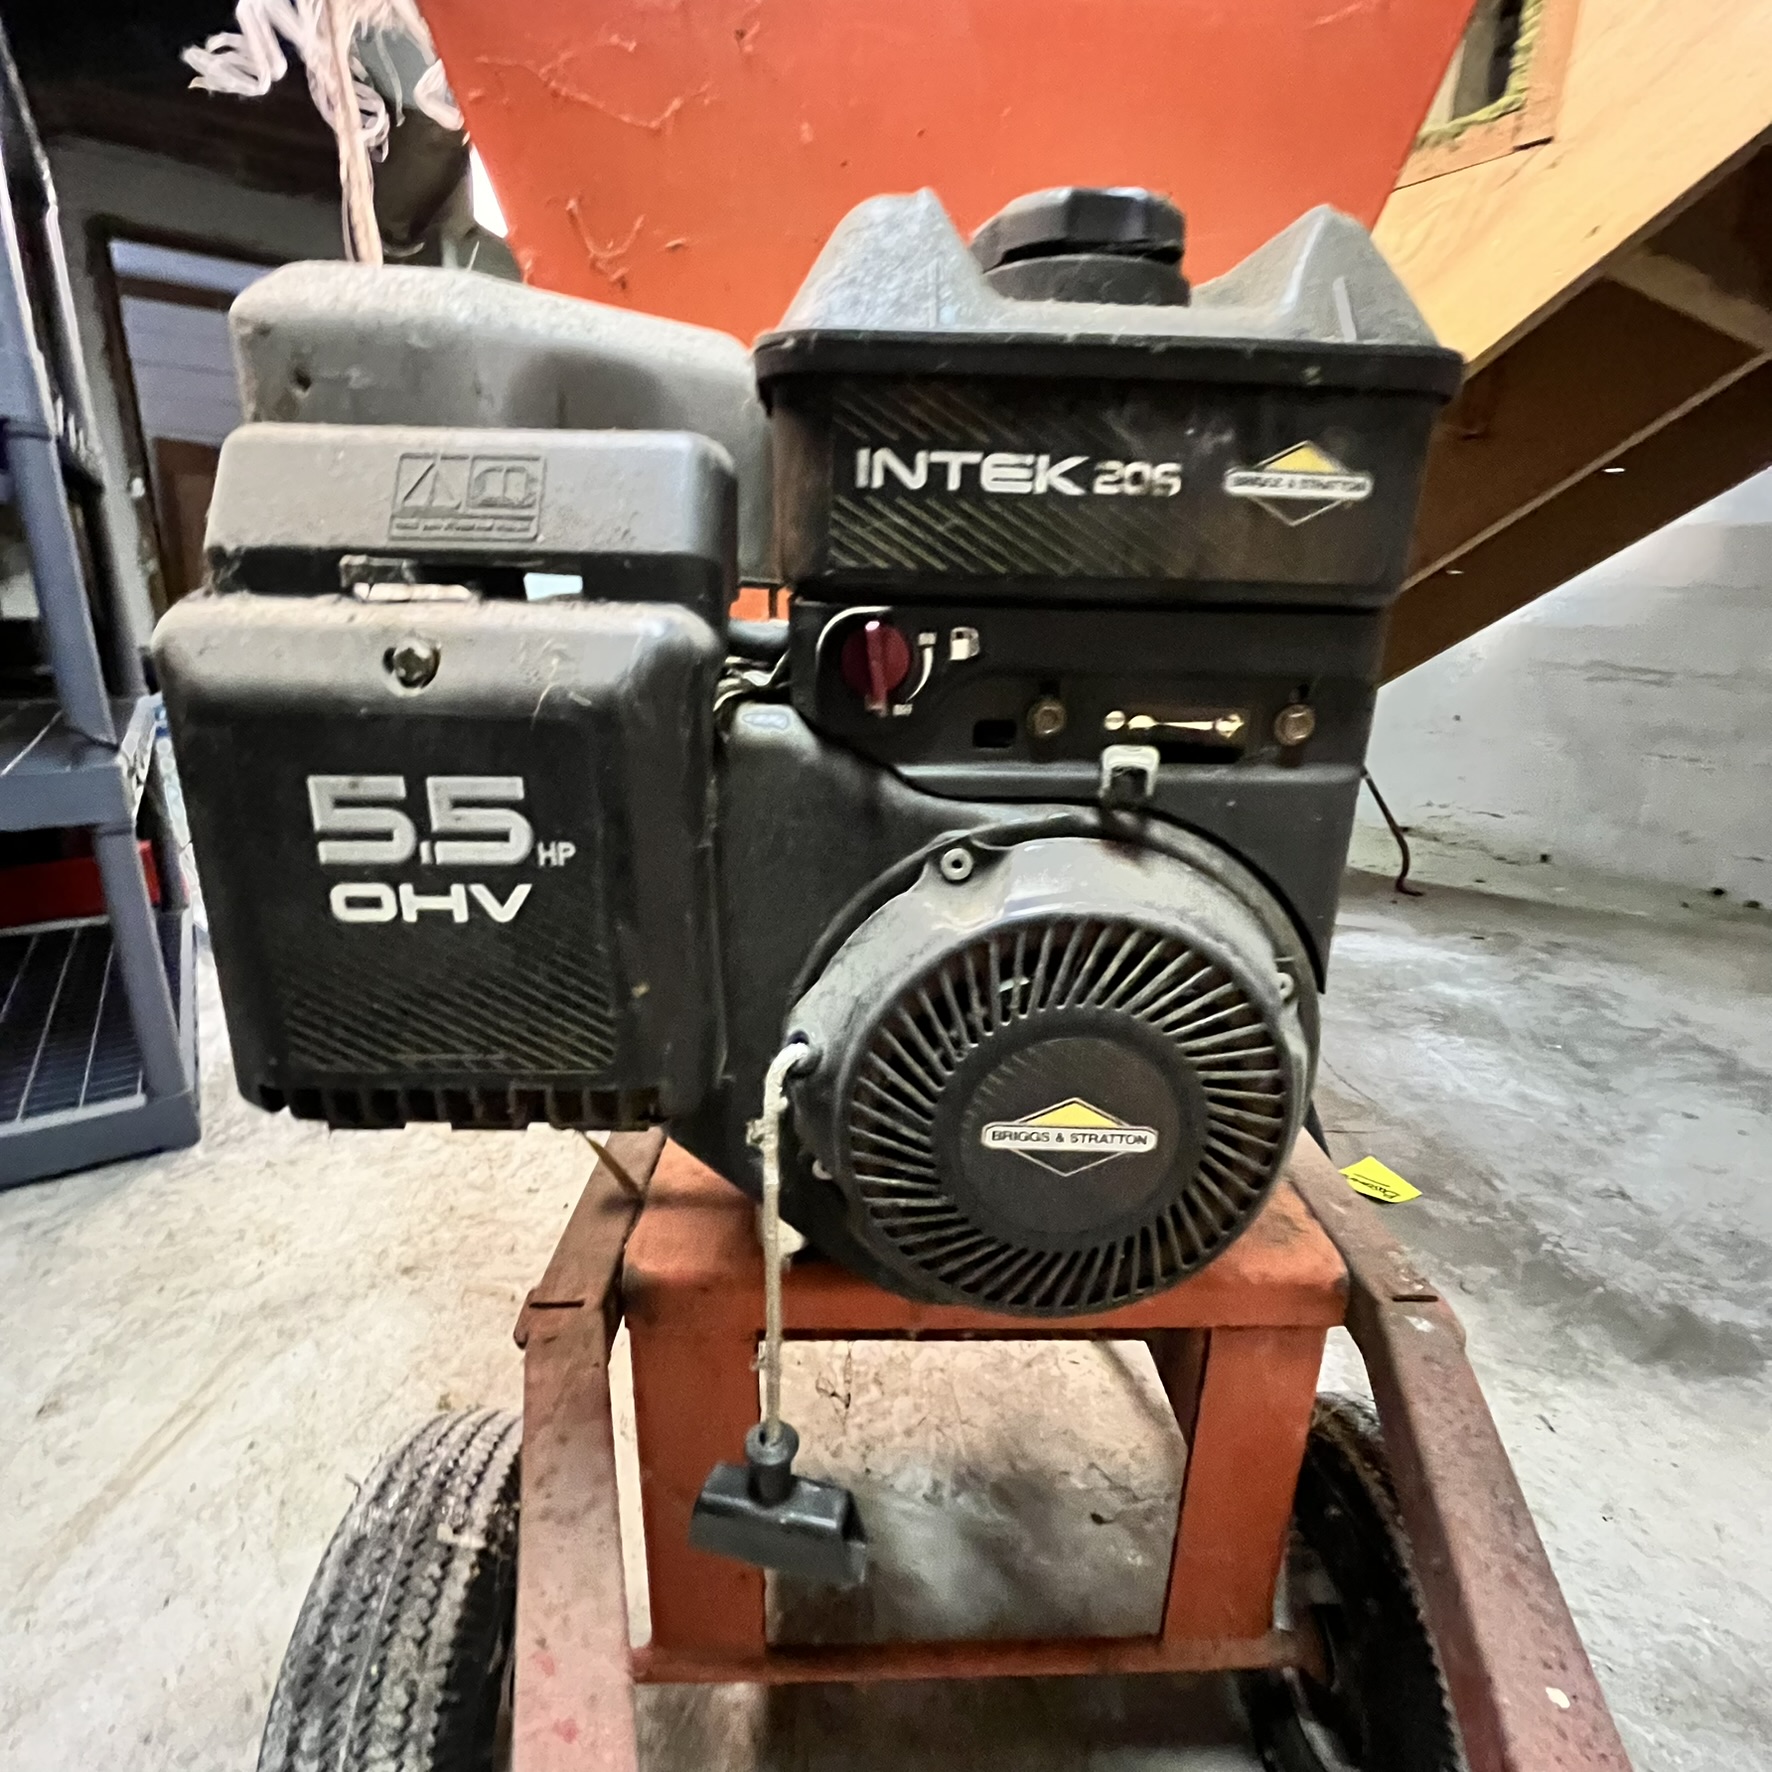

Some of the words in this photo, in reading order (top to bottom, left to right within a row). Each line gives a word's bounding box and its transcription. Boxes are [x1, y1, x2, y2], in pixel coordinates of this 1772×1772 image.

[854, 447, 1090, 496] INTEK
[307, 774, 535, 866] 5.5
[536, 841, 577, 867] HP
[329, 881, 533, 923] OHV
[991, 1130, 1050, 1143] BRIGGS
[1055, 1132, 1065, 1143] &
[1070, 1132, 1148, 1146] STRATTON
